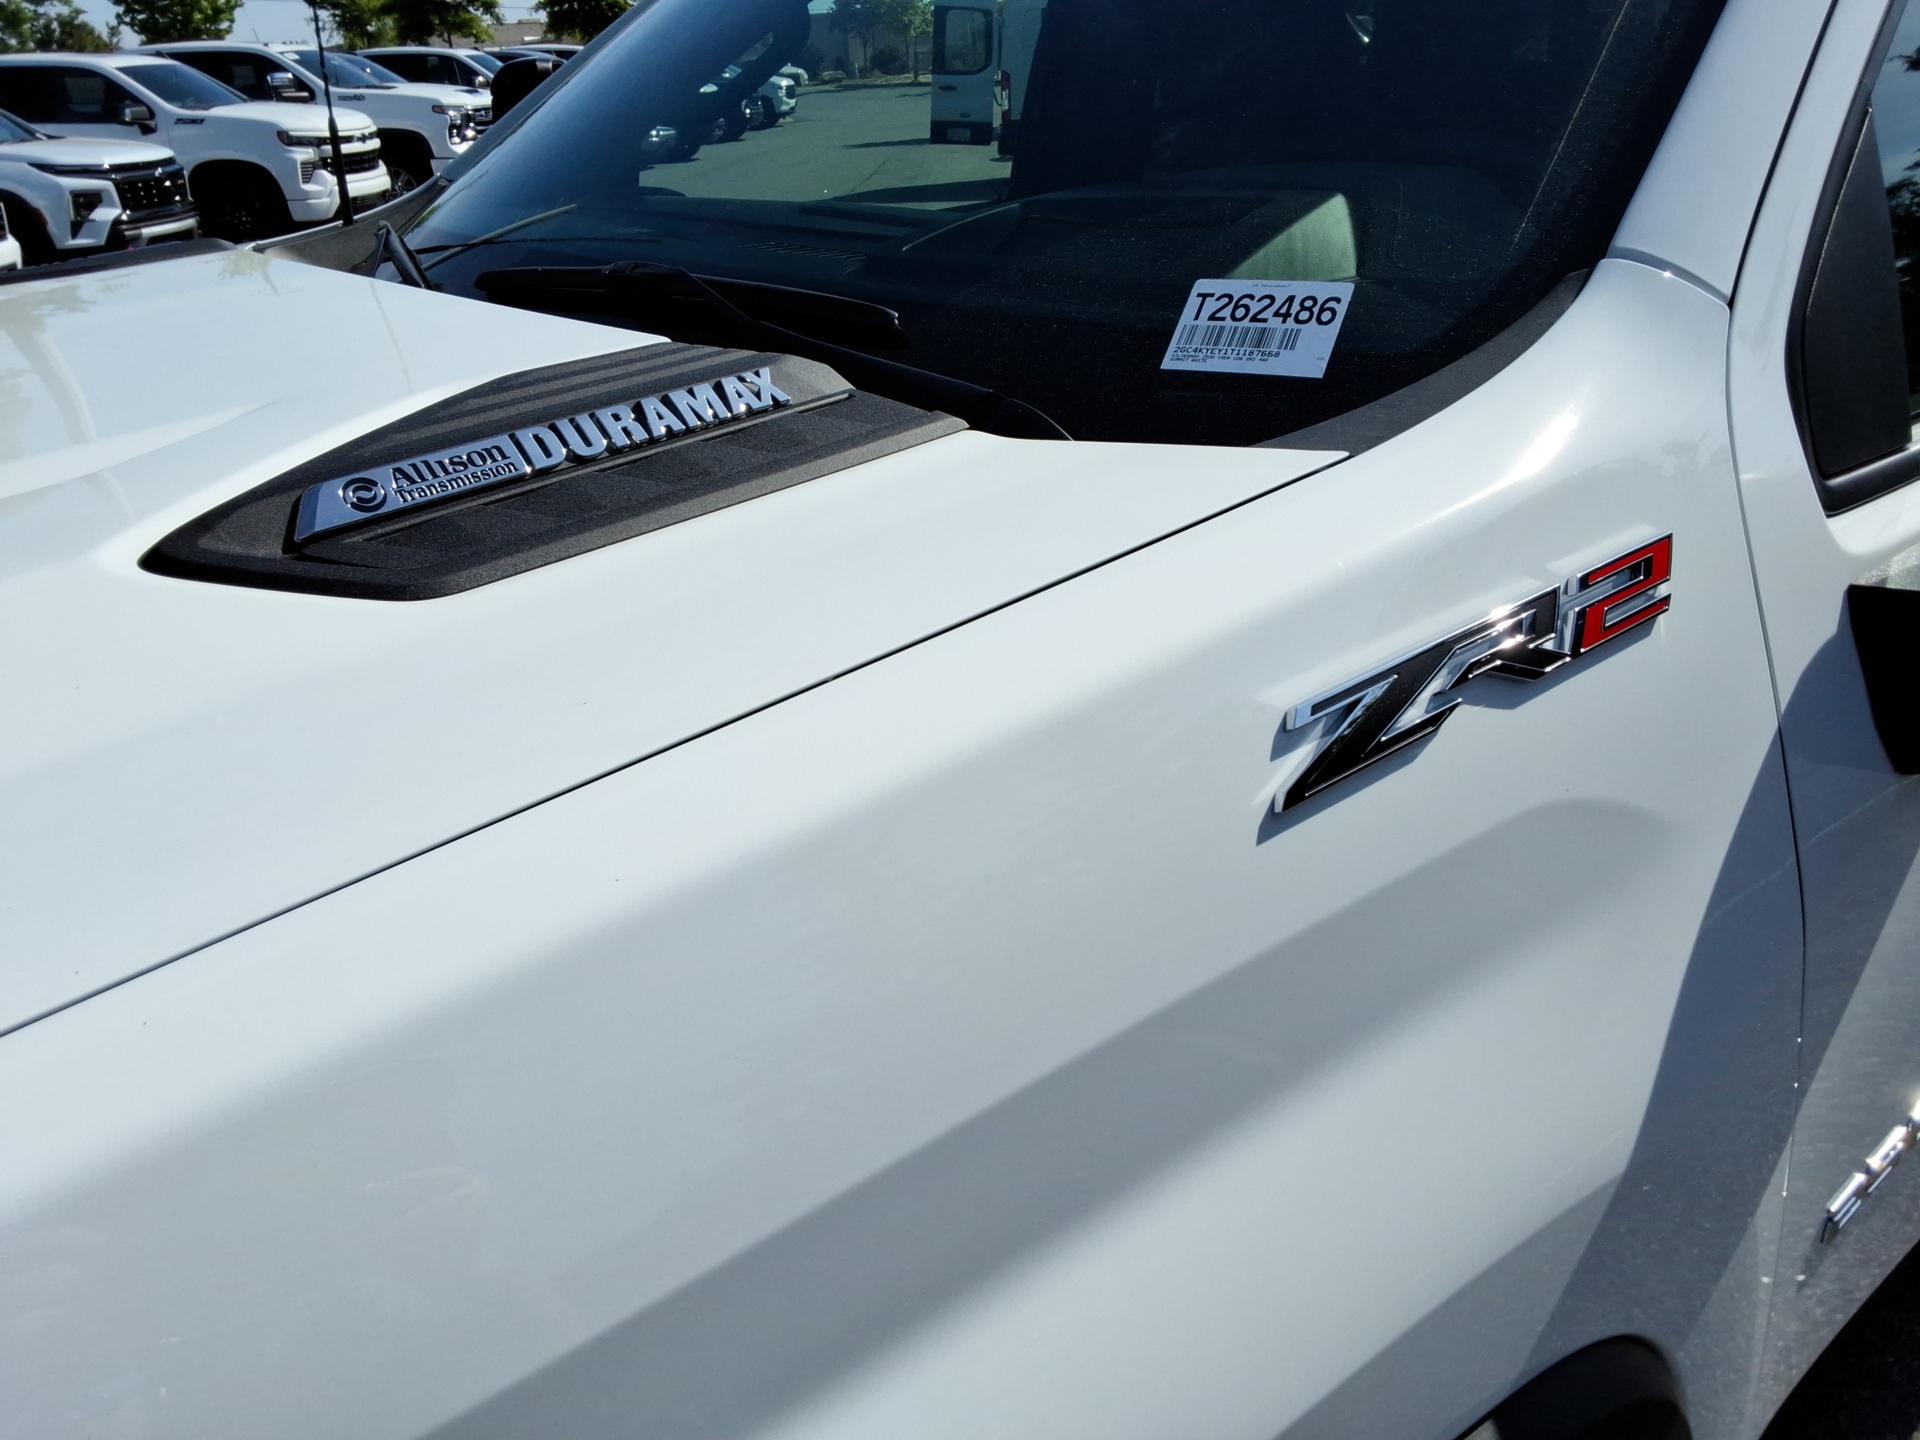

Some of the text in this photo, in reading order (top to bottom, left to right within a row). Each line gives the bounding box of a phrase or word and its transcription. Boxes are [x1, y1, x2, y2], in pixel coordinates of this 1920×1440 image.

[1193, 292, 1342, 326] T262486
[1173, 346, 1281, 358] 2GC4KYEY1T1187668
[515, 366, 792, 472] DURAMAX
[390, 443, 511, 489] Allison
[392, 461, 520, 505] Transmission
[1272, 532, 1673, 813] ZR2
